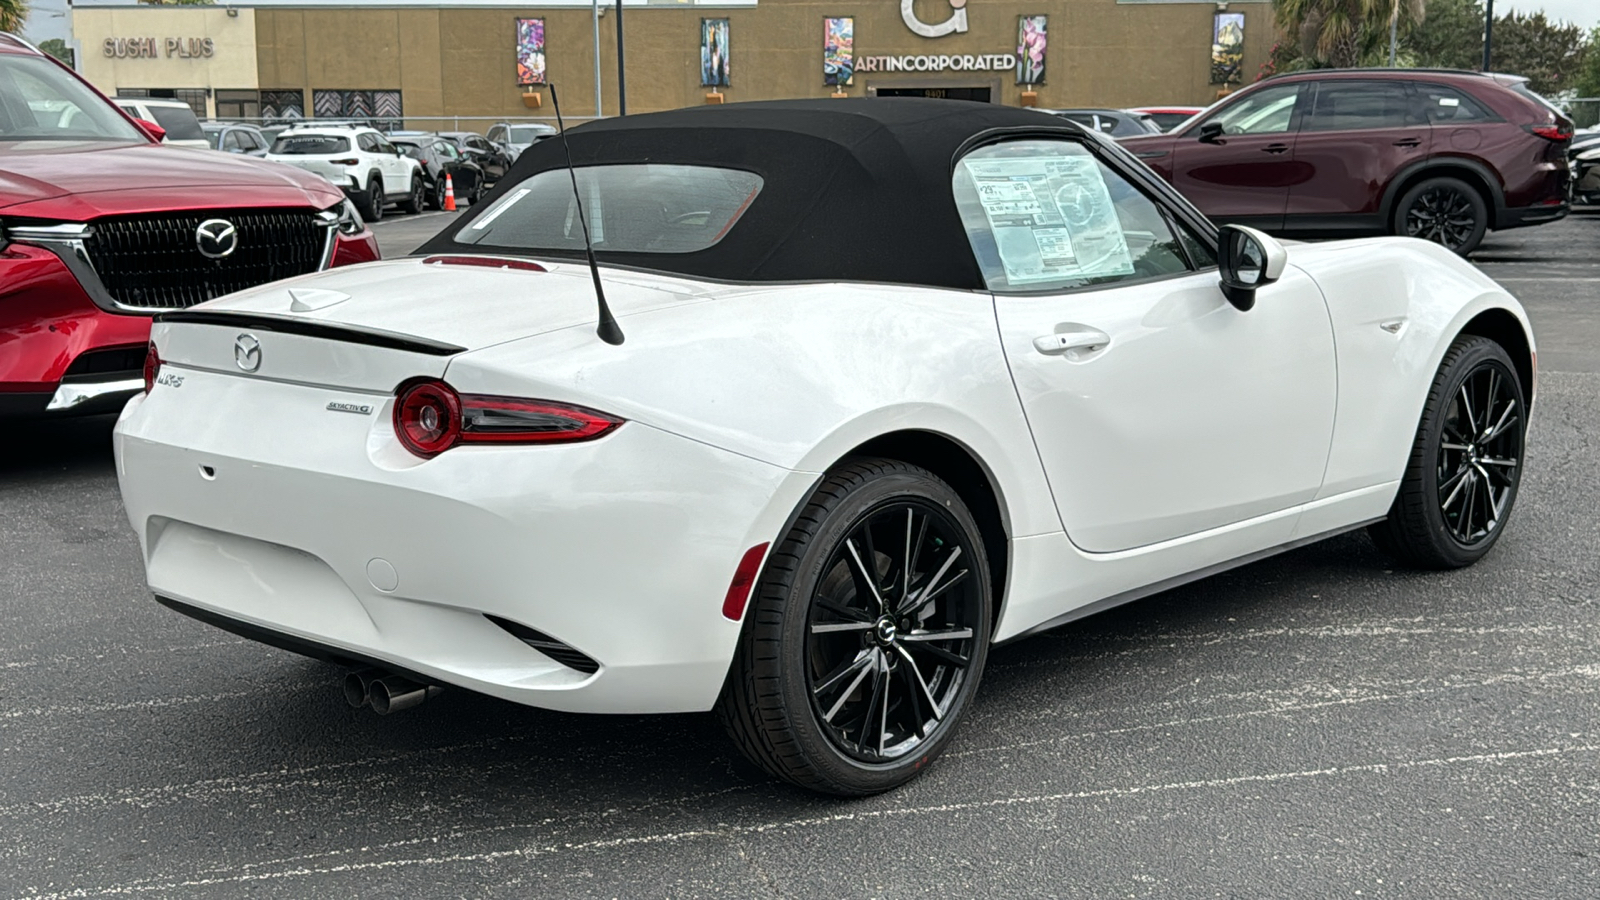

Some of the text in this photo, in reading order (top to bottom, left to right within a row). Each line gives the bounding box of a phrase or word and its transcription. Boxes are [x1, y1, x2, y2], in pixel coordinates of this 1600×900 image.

[103, 37, 214, 58] SUSHI PLUS
[854, 54, 1016, 72] ARTINCORPORATED
[925, 89, 946, 98] 9401
